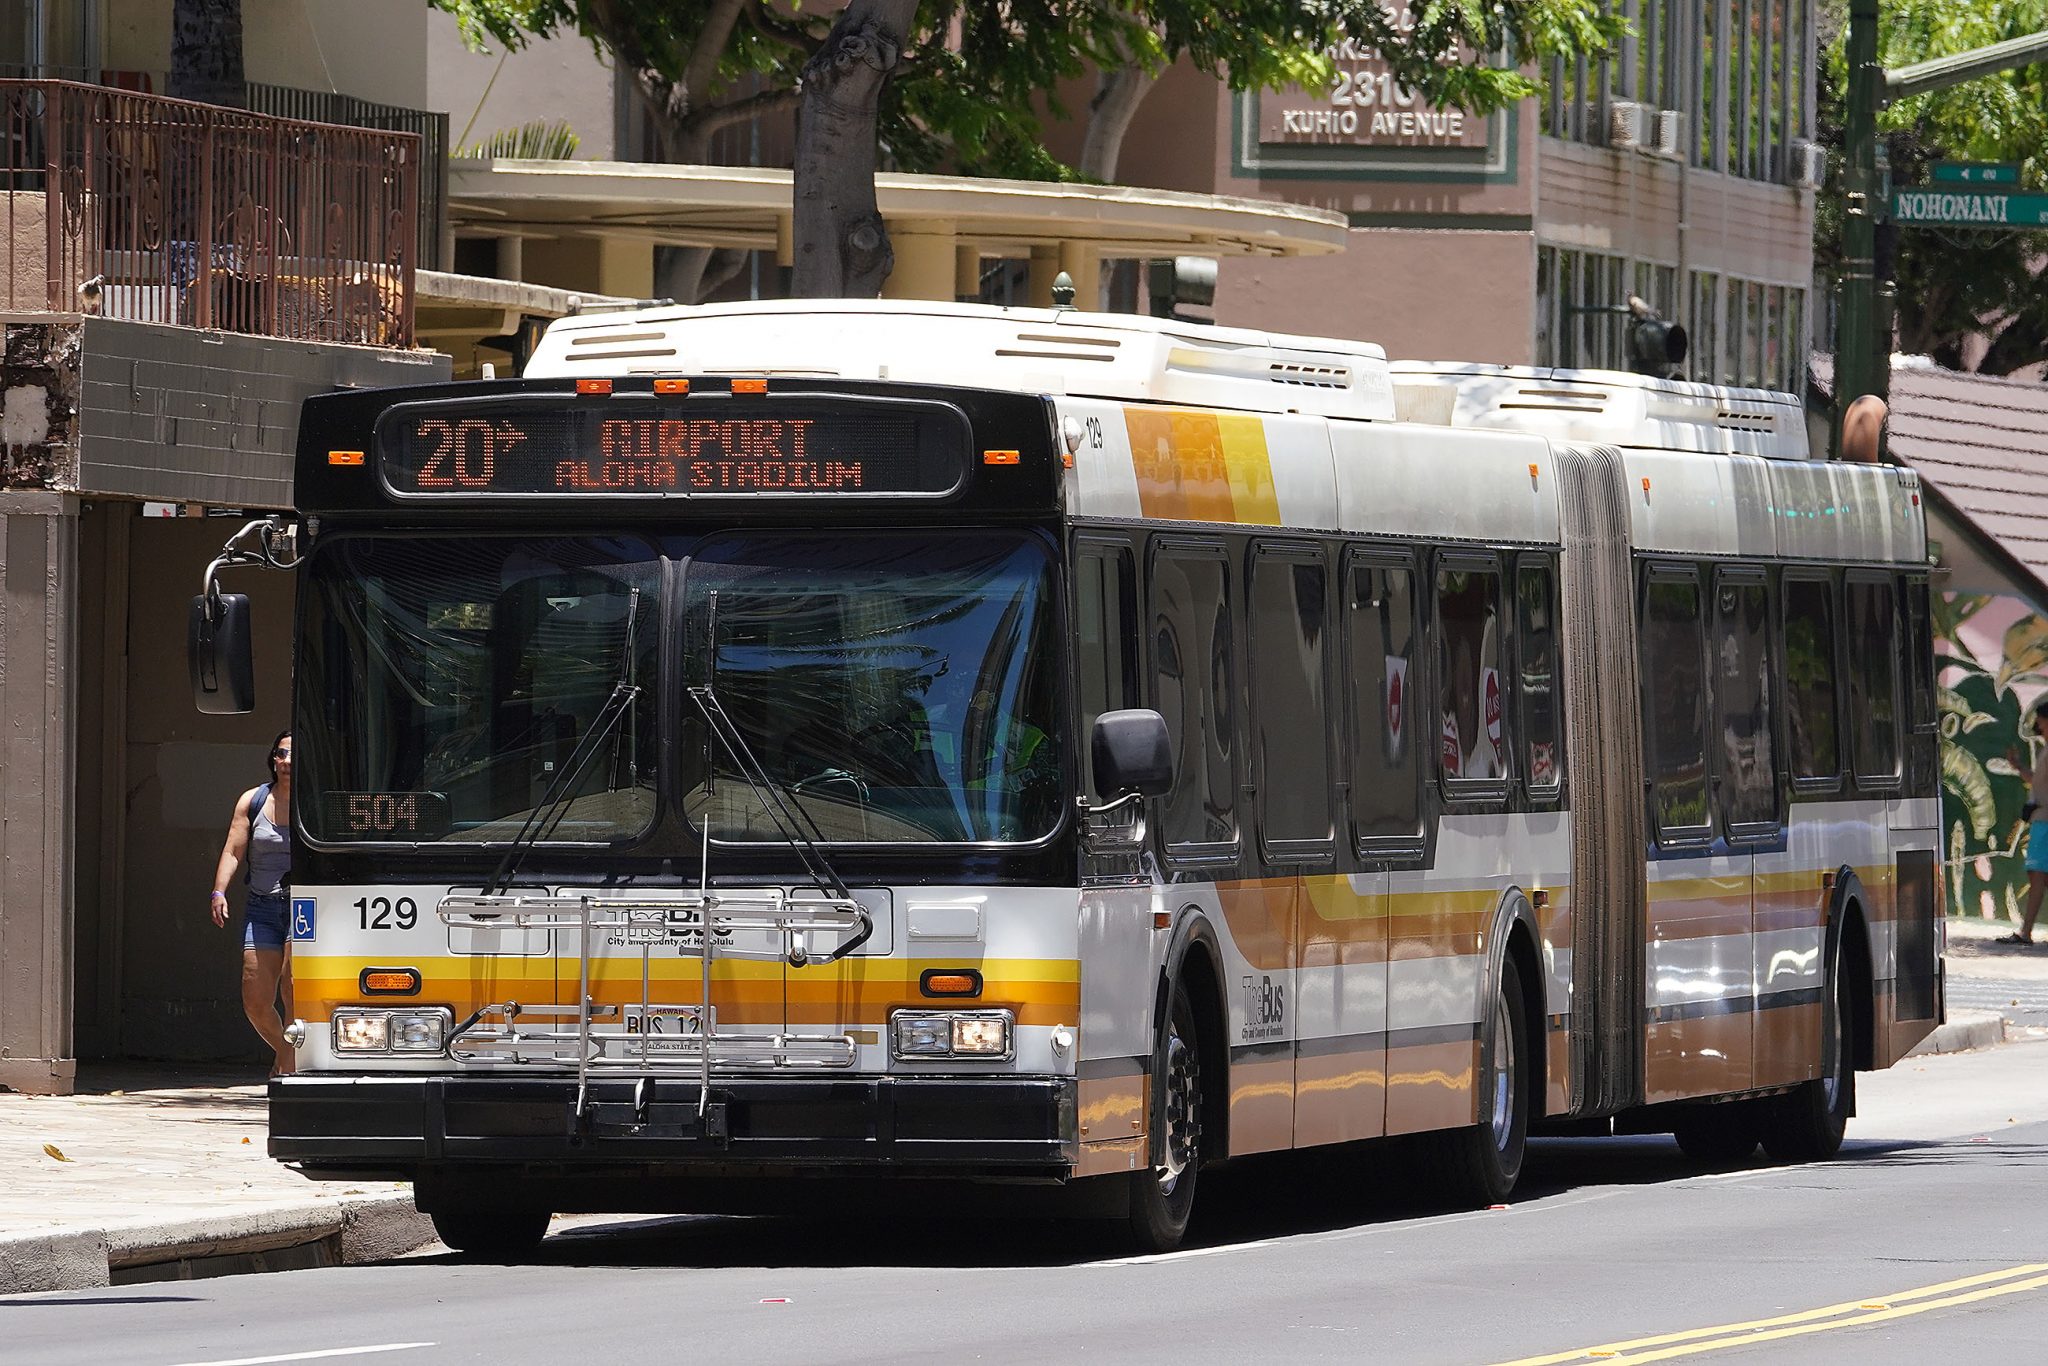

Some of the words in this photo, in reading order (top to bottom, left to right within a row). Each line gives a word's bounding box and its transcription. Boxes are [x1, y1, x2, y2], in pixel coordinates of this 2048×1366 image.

[1283, 110, 1357, 135] KUHIO
[1371, 111, 1464, 137] AVENUE
[1897, 193, 2009, 223] NOHONANI
[601, 419, 815, 458] AIRPORT
[1085, 416, 1103, 449] 129
[417, 419, 494, 487] 20
[555, 460, 676, 487] ALOHA
[690, 460, 862, 487] STADIUM
[350, 795, 418, 830] 504
[353, 896, 418, 930] 129
[607, 937, 625, 947] City
[681, 938, 691, 946] of
[693, 937, 734, 946] Hoolulu
[1242, 976, 1283, 1025] TheBus
[677, 1016, 704, 1034] 12
